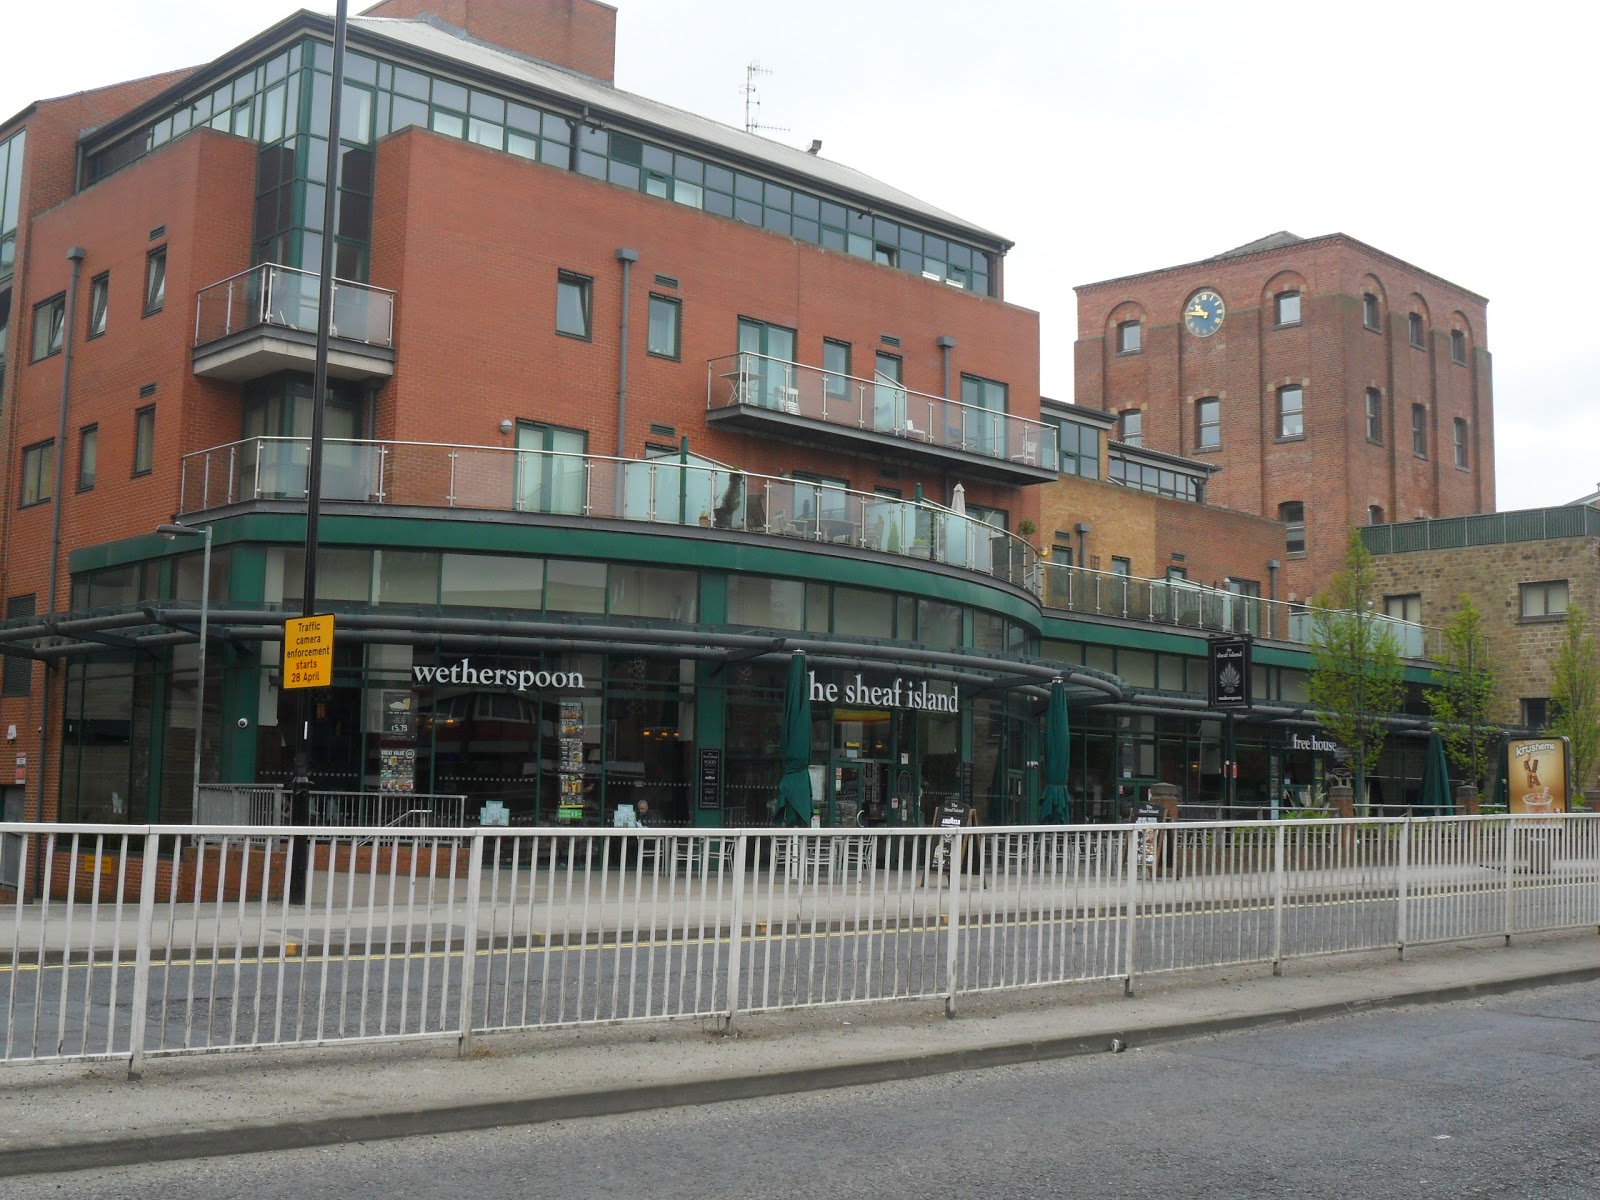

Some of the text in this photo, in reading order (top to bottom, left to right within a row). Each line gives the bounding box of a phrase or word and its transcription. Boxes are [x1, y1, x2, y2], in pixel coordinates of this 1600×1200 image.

[298, 621, 321, 632] Traffic
[296, 635, 321, 645] camera
[287, 645, 330, 658] enforcement
[296, 659, 318, 670] starts
[291, 671, 320, 683] 28 April
[413, 657, 585, 692] wetherspoon
[808, 670, 959, 713] he sheaf island
[1291, 733, 1337, 752] free house
